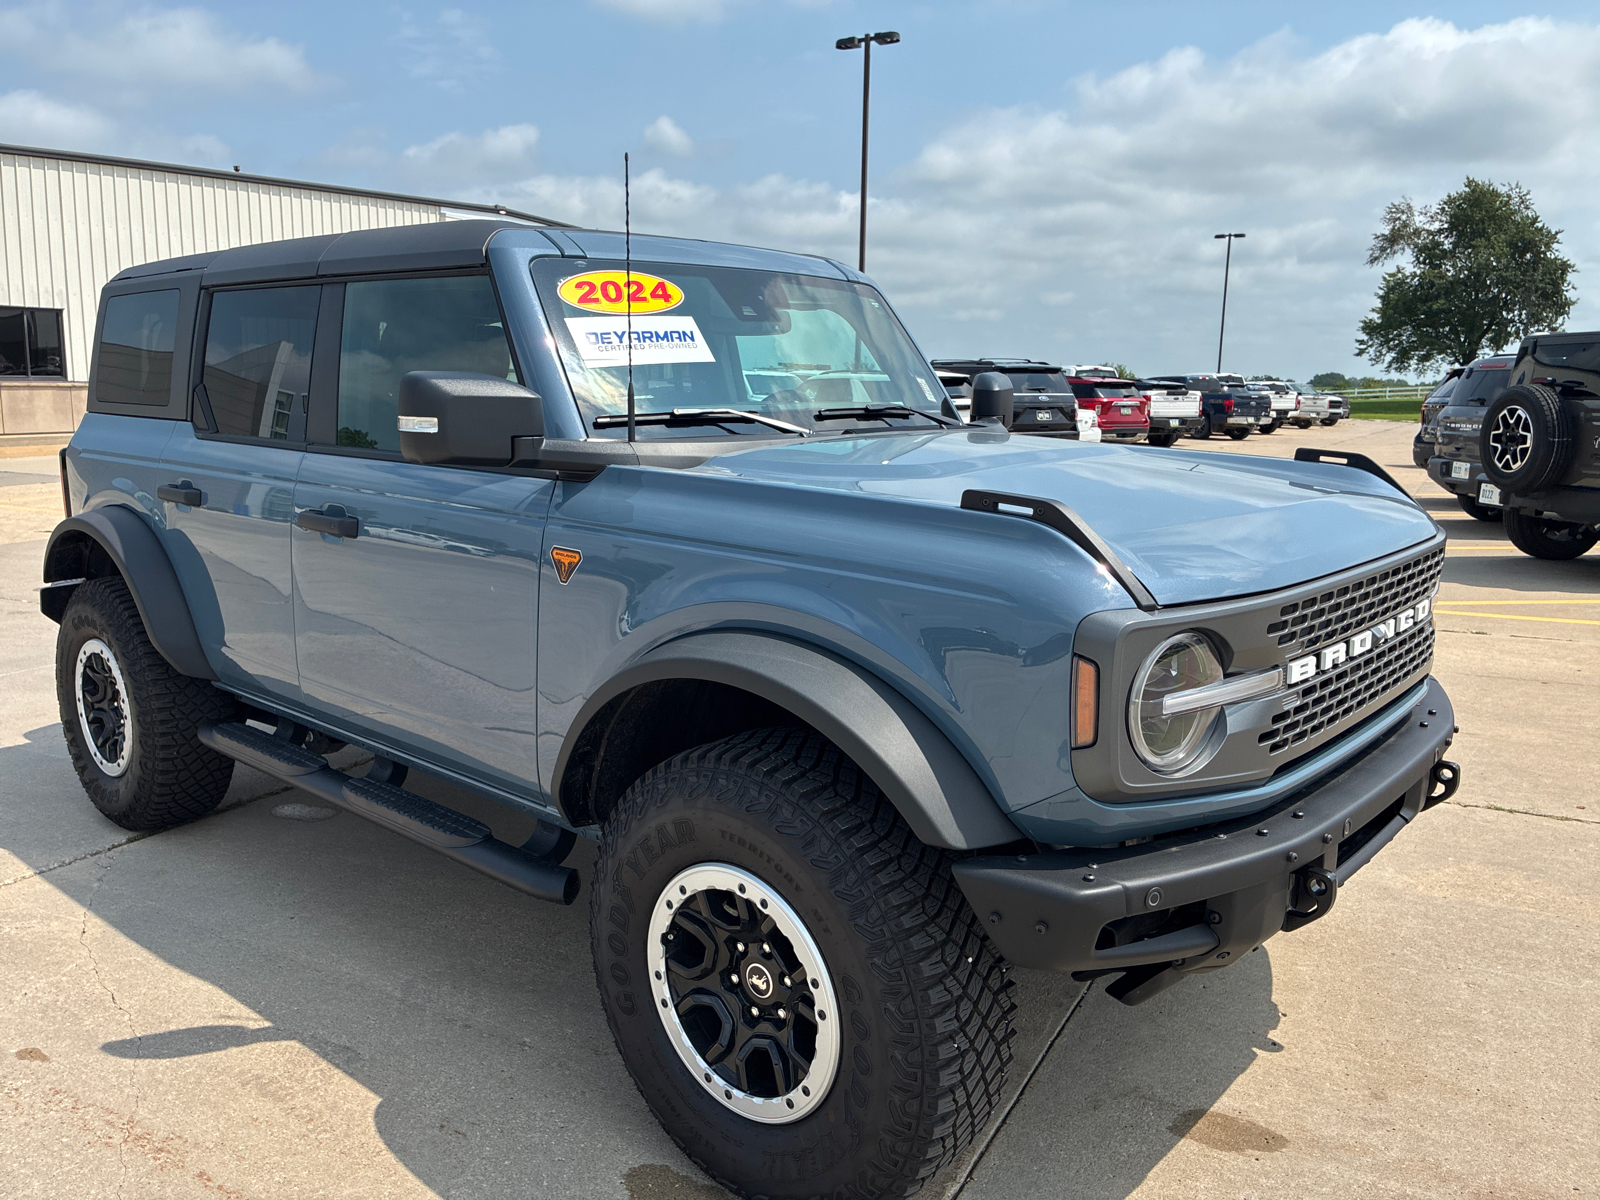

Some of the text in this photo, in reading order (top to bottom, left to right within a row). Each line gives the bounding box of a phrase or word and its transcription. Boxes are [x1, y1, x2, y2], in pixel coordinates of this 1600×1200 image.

[574, 280, 672, 304] 2024
[585, 330, 695, 345] DEYARMAN
[648, 342, 698, 350] PRE-OWNED
[1287, 599, 1430, 685] BRONCO
[719, 828, 805, 892] TERRITORY
[606, 818, 698, 1017] GOODYEAR
